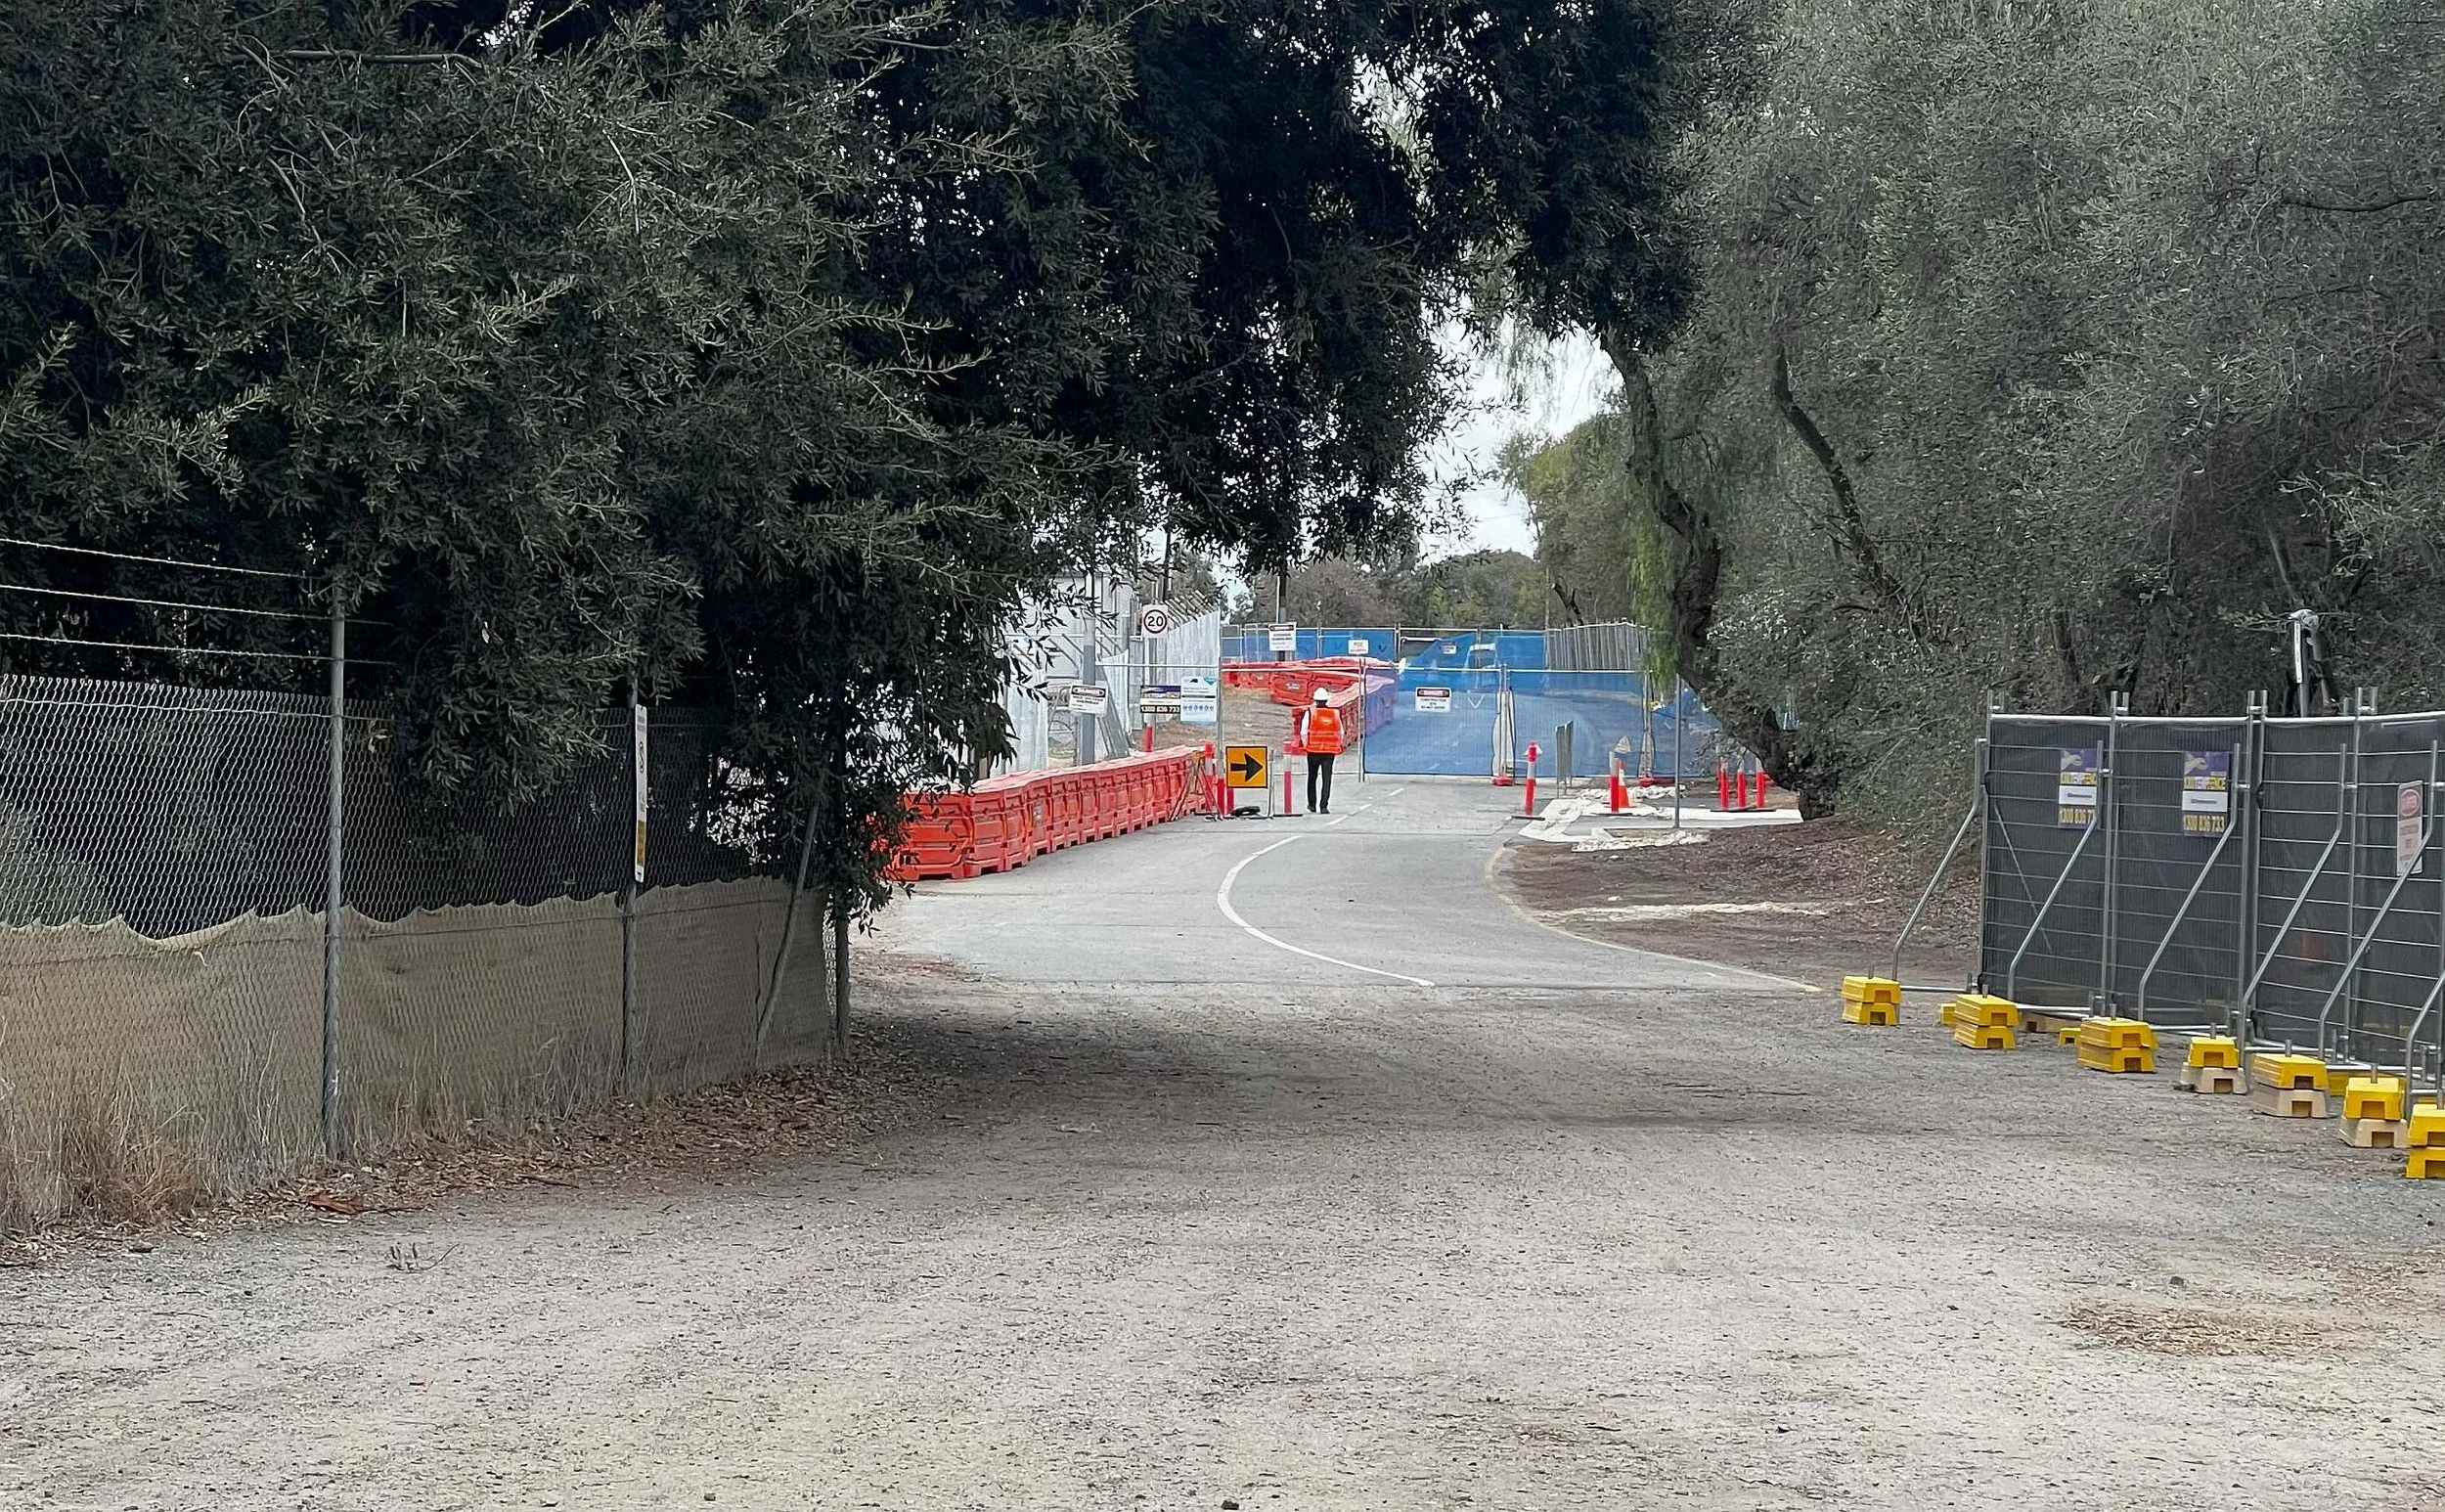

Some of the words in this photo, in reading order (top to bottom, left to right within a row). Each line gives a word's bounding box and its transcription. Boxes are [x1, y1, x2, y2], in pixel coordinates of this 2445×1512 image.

[1147, 615, 1164, 627] 20
[2183, 815, 2198, 831] 1300
[2199, 815, 2211, 832] 836
[2211, 816, 2225, 833] 733
